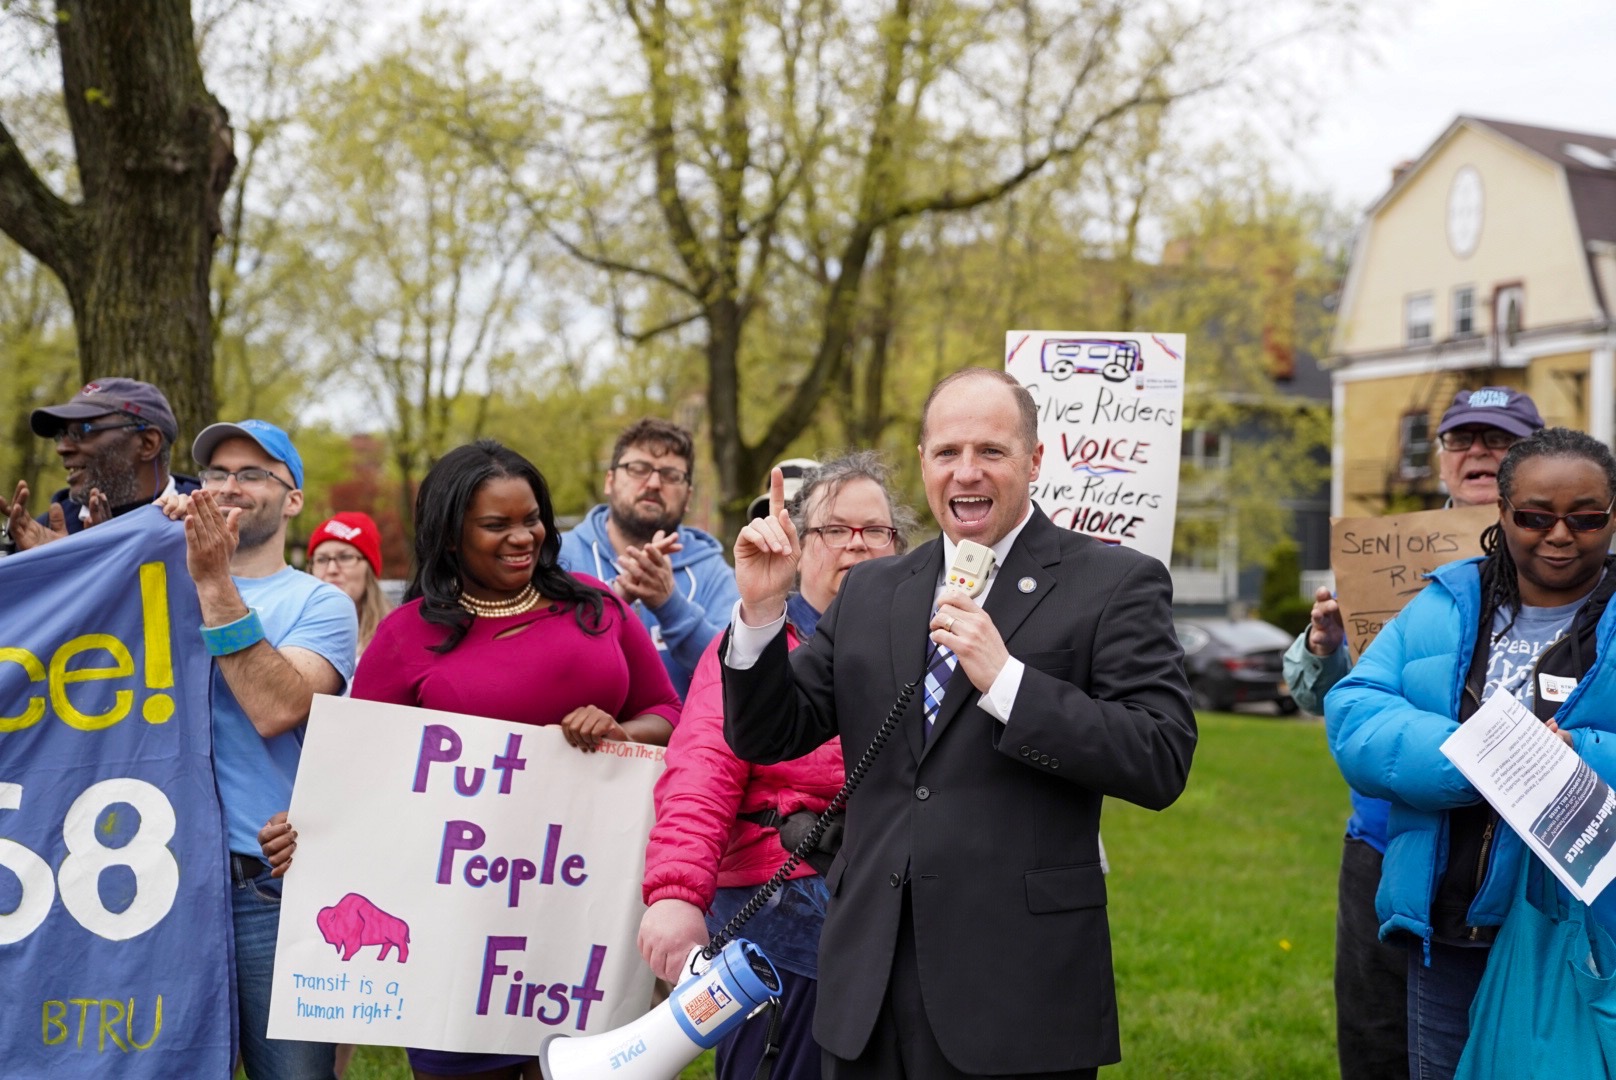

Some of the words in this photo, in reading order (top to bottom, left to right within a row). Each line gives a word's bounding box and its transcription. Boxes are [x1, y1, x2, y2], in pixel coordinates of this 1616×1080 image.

[1092, 386, 1176, 426] Riders
[1062, 433, 1151, 463] VOICE
[1080, 475, 1162, 509] Riders
[1051, 507, 1145, 538] CHOICE
[1342, 524, 1459, 559] SENIORS
[411, 724, 527, 797] Put
[595, 741, 616, 754] ers
[617, 743, 633, 757] On
[635, 745, 654, 759] The
[1560, 796, 1568, 805] BILL
[1566, 777, 1582, 797] SUPPORT
[435, 820, 588, 908] People
[293, 973, 350, 991] Transit
[360, 975, 374, 995] is
[385, 981, 399, 996] a
[475, 935, 607, 1031] First
[297, 996, 344, 1020] human
[352, 998, 404, 1024] right!
[686, 990, 711, 1014] JUSTICE
[42, 994, 163, 1053] BTRU
[610, 1038, 647, 1071] PYLE
